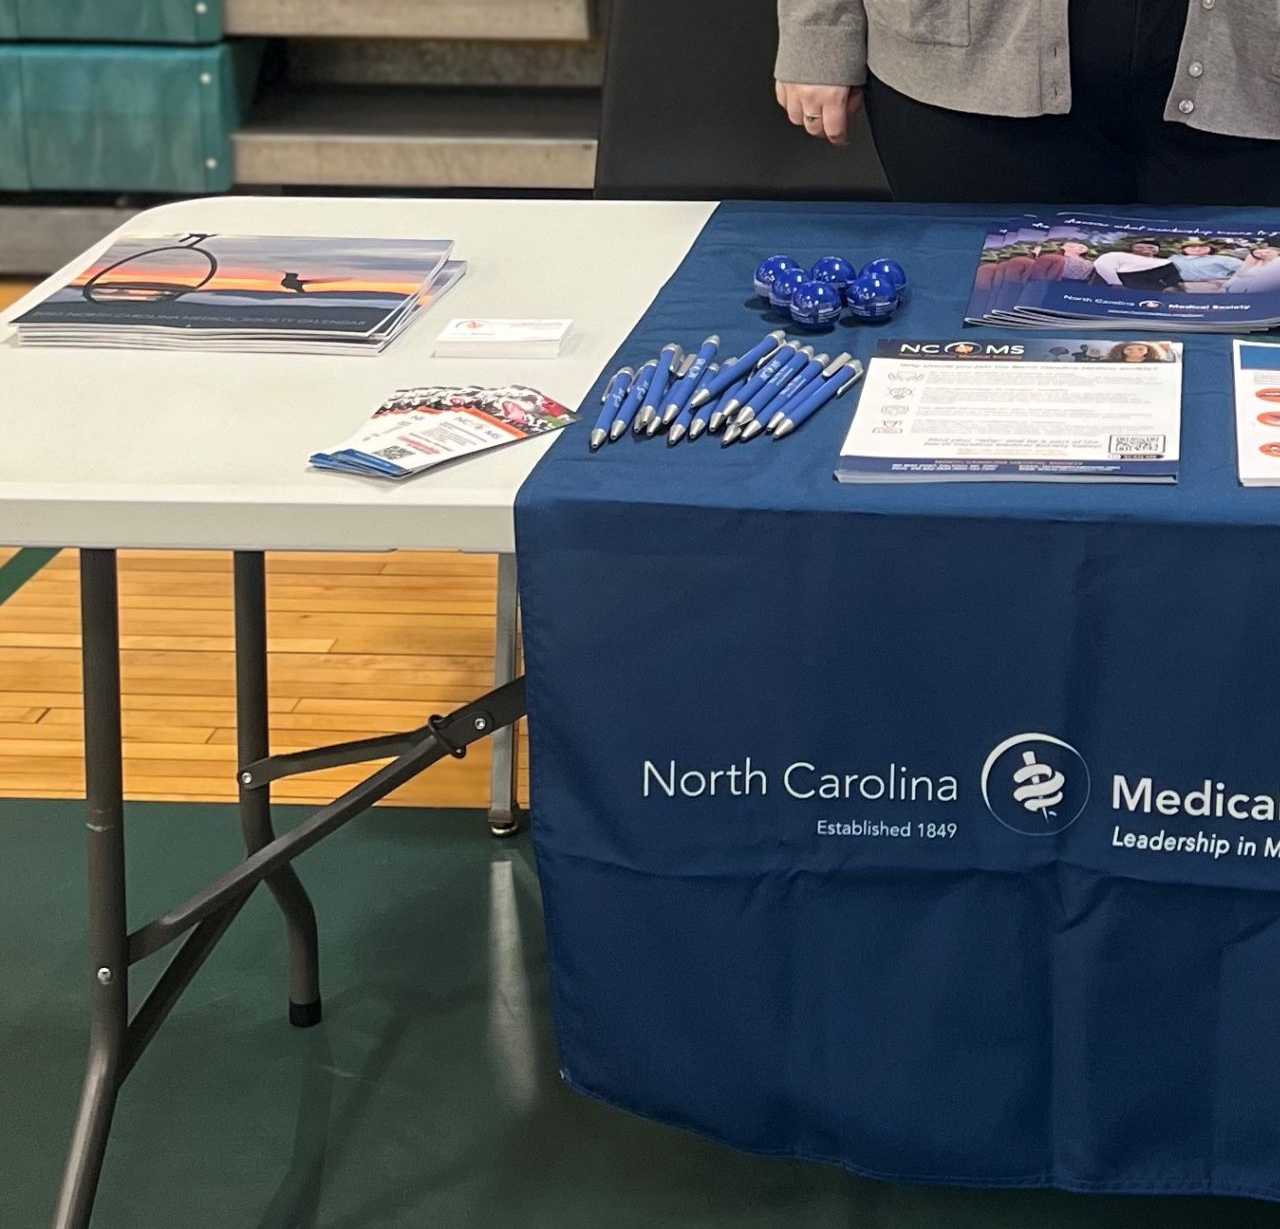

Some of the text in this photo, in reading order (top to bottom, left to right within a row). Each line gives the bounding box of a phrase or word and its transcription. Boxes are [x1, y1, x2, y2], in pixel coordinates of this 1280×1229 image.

[1063, 295, 1092, 303] North
[900, 344, 1025, 354] NC MS
[641, 758, 958, 803] North Carolina
[817, 819, 958, 840] Established 1849
[1111, 827, 1230, 859] Leadership
[1239, 835, 1256, 855] in
